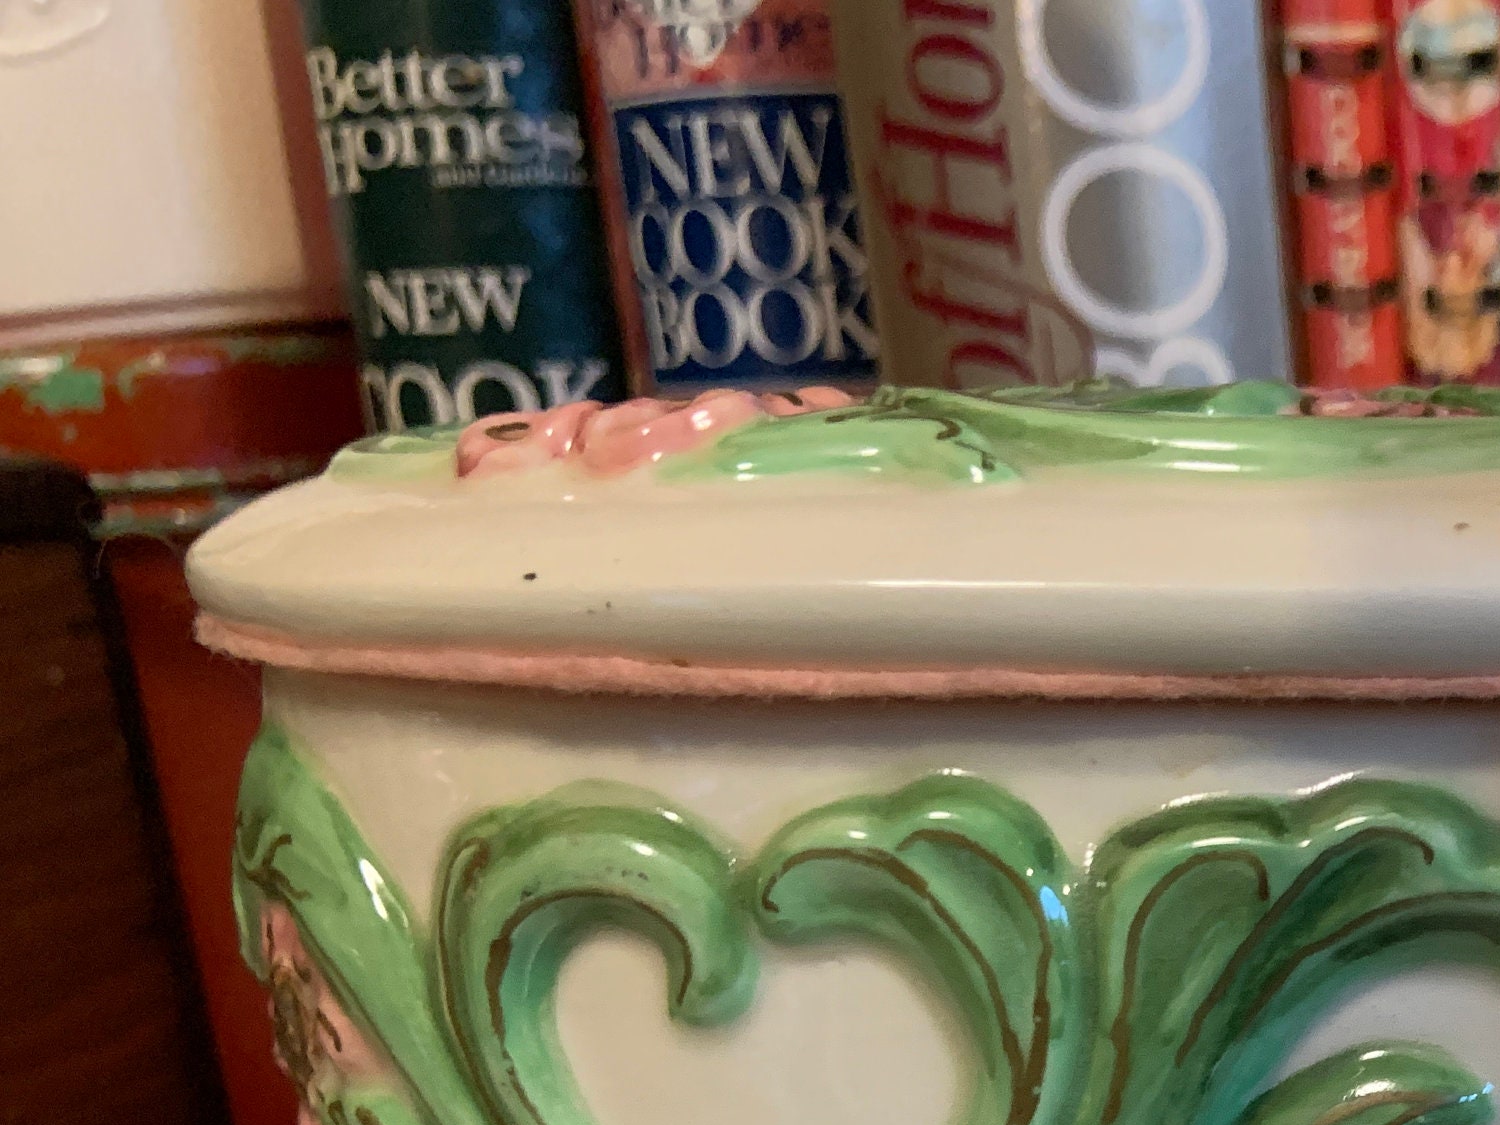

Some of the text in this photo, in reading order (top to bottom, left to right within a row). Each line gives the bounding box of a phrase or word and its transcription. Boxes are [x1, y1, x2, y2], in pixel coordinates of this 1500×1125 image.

[306, 46, 526, 121] Better
[319, 110, 585, 194] Homes
[631, 108, 830, 204] NEW
[630, 194, 869, 287] COOK
[365, 265, 532, 339] NEW
[644, 277, 881, 370] BOOK
